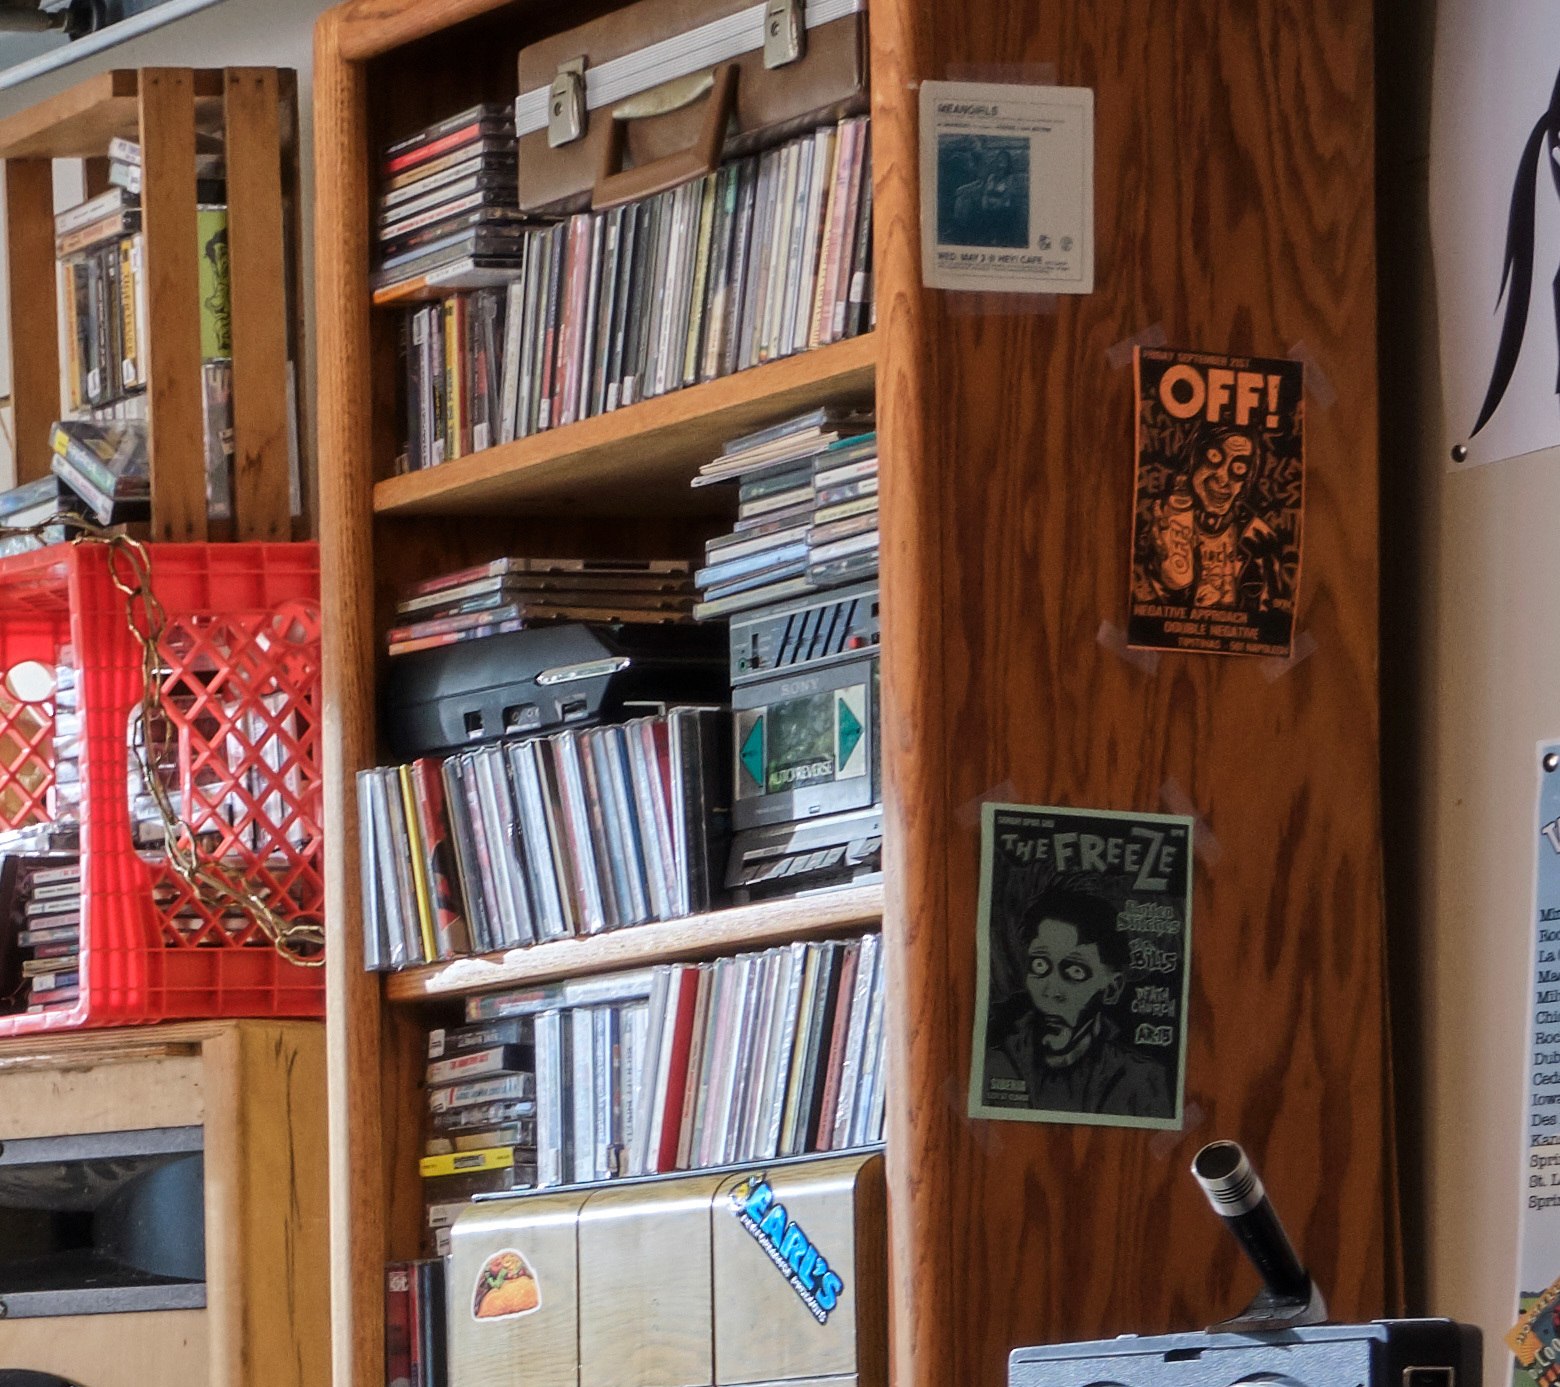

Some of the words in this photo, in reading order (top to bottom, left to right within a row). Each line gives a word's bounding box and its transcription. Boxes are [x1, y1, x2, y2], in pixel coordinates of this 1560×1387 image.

[1159, 364, 1282, 429] OFF!
[780, 677, 821, 697] SONY
[795, 759, 834, 780] REVERSE
[1000, 833, 1051, 862] THE
[1052, 827, 1178, 891] FREEZE
[1530, 1114, 1557, 1127] Des
